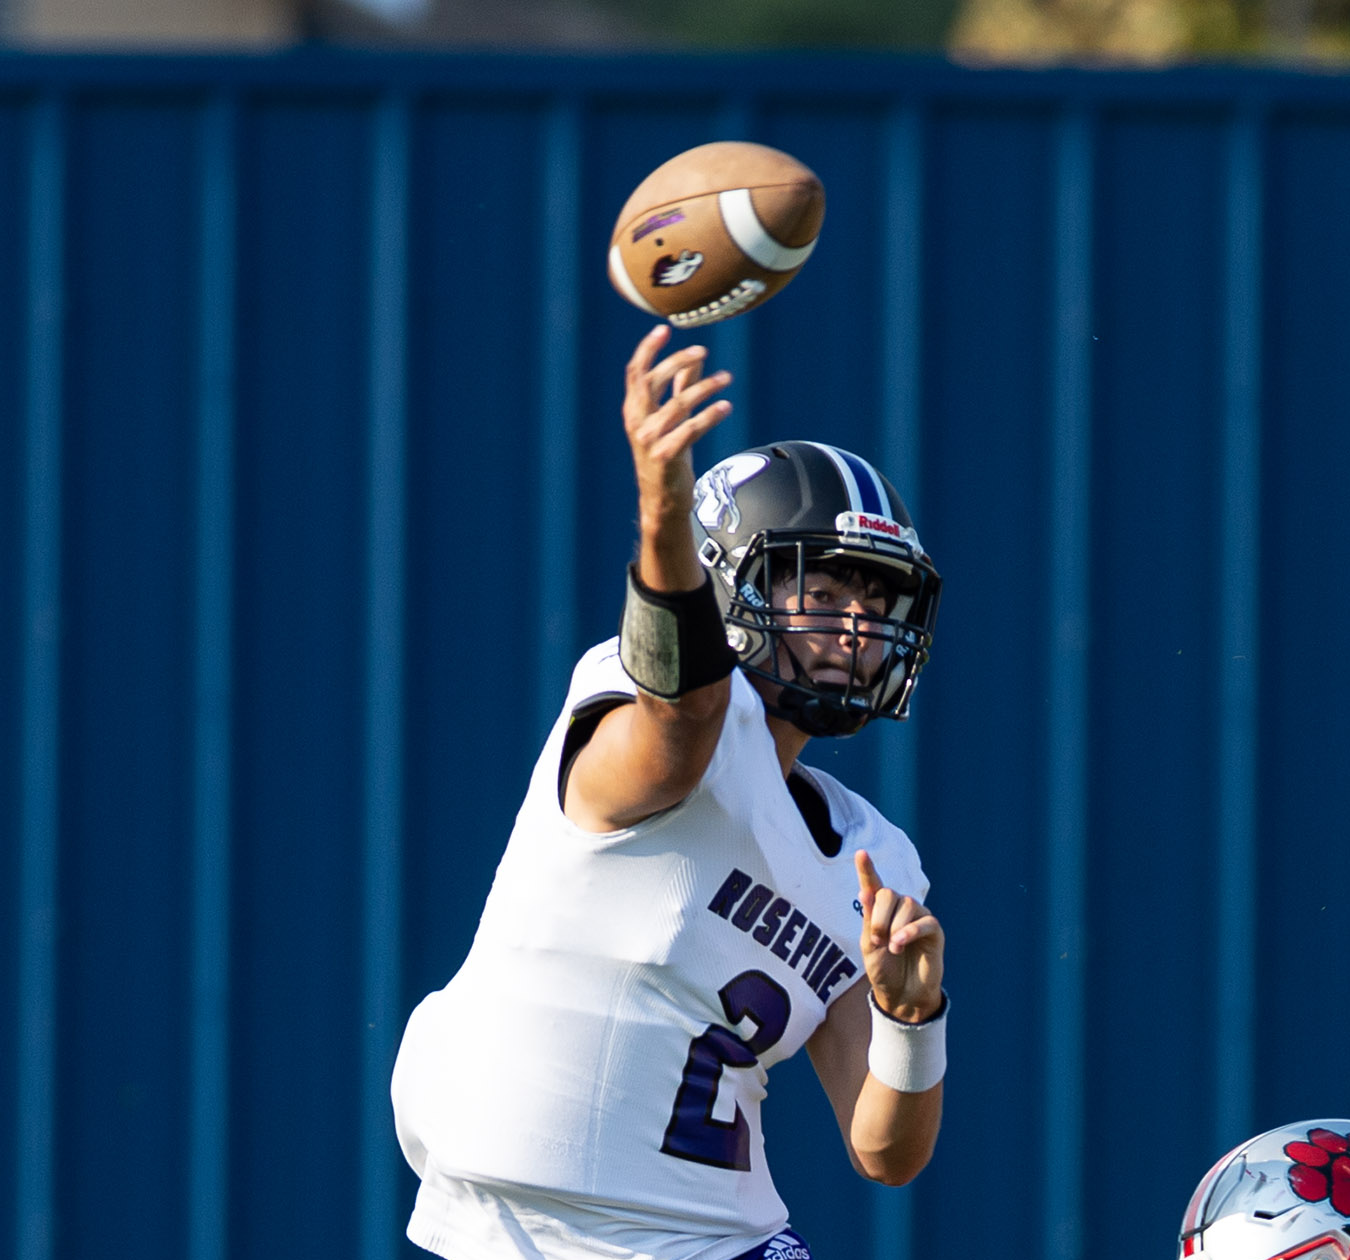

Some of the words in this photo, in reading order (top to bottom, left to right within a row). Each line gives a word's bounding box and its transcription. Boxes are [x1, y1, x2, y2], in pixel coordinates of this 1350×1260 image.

[858, 514, 900, 537] Riddell
[707, 868, 858, 1005] ROSEPINE
[659, 969, 792, 1173] 2
